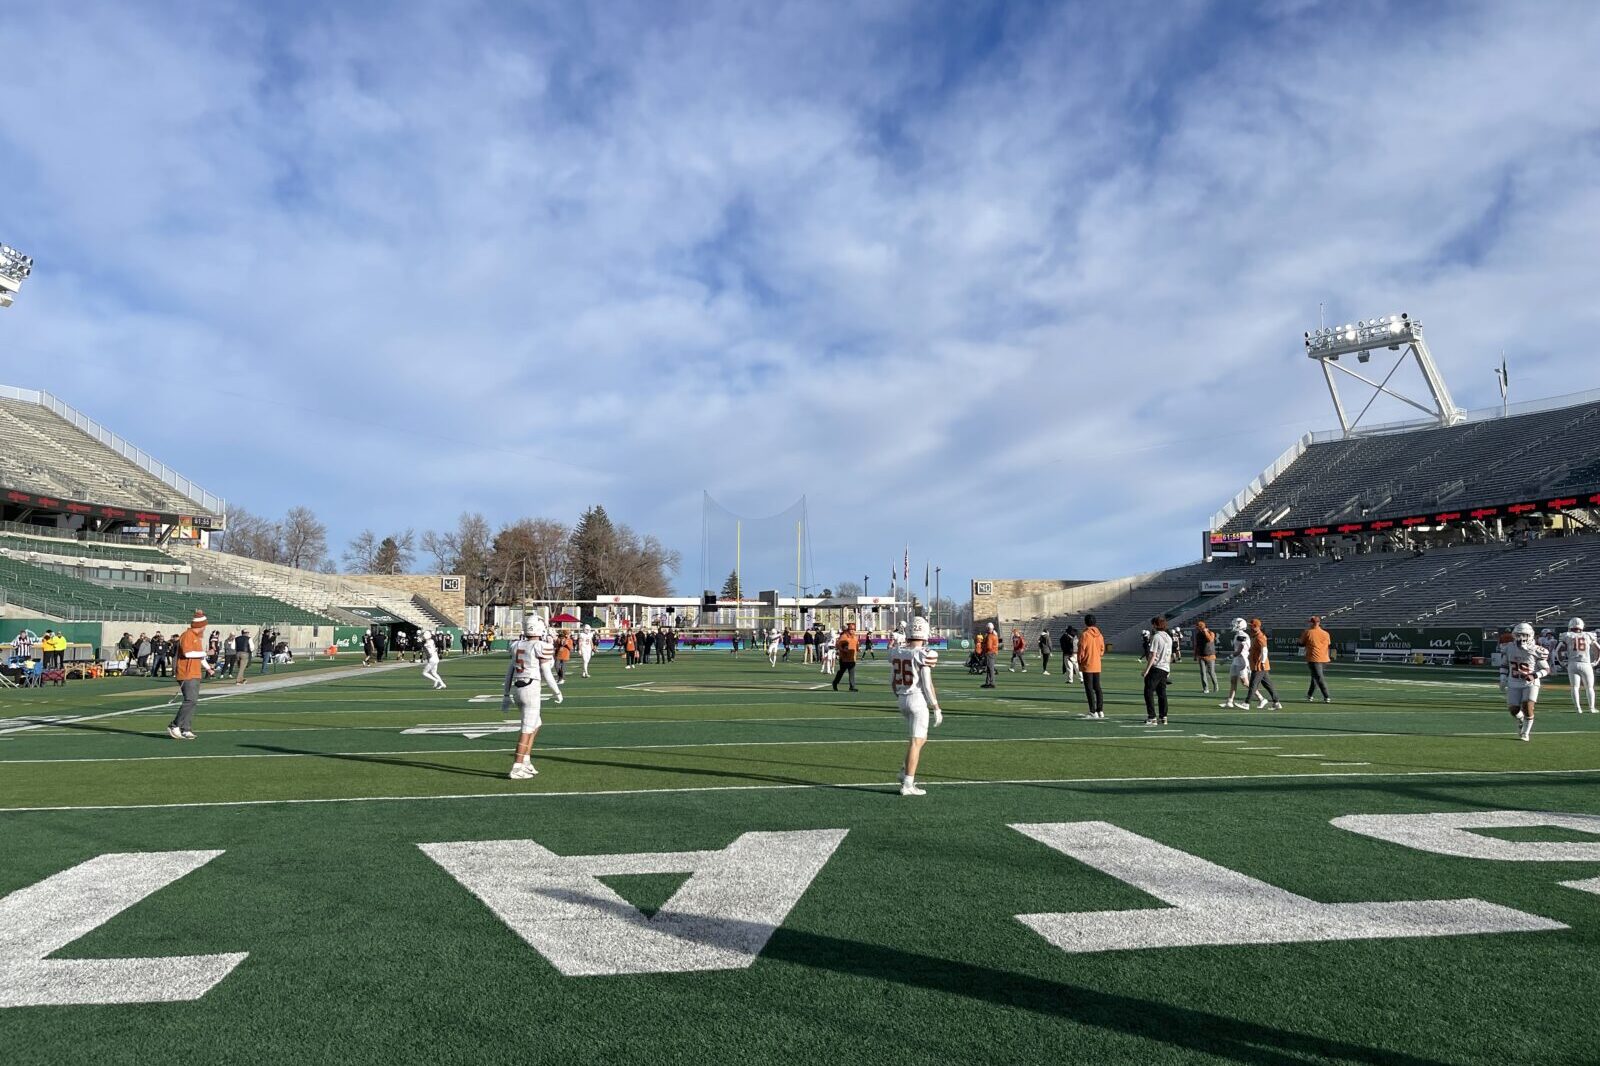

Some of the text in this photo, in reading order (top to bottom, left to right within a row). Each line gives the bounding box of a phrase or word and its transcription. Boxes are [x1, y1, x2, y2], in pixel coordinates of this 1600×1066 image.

[445, 580, 457, 589] 40
[979, 584, 991, 593] 40
[515, 649, 525, 673] 5
[892, 658, 914, 687] 26
